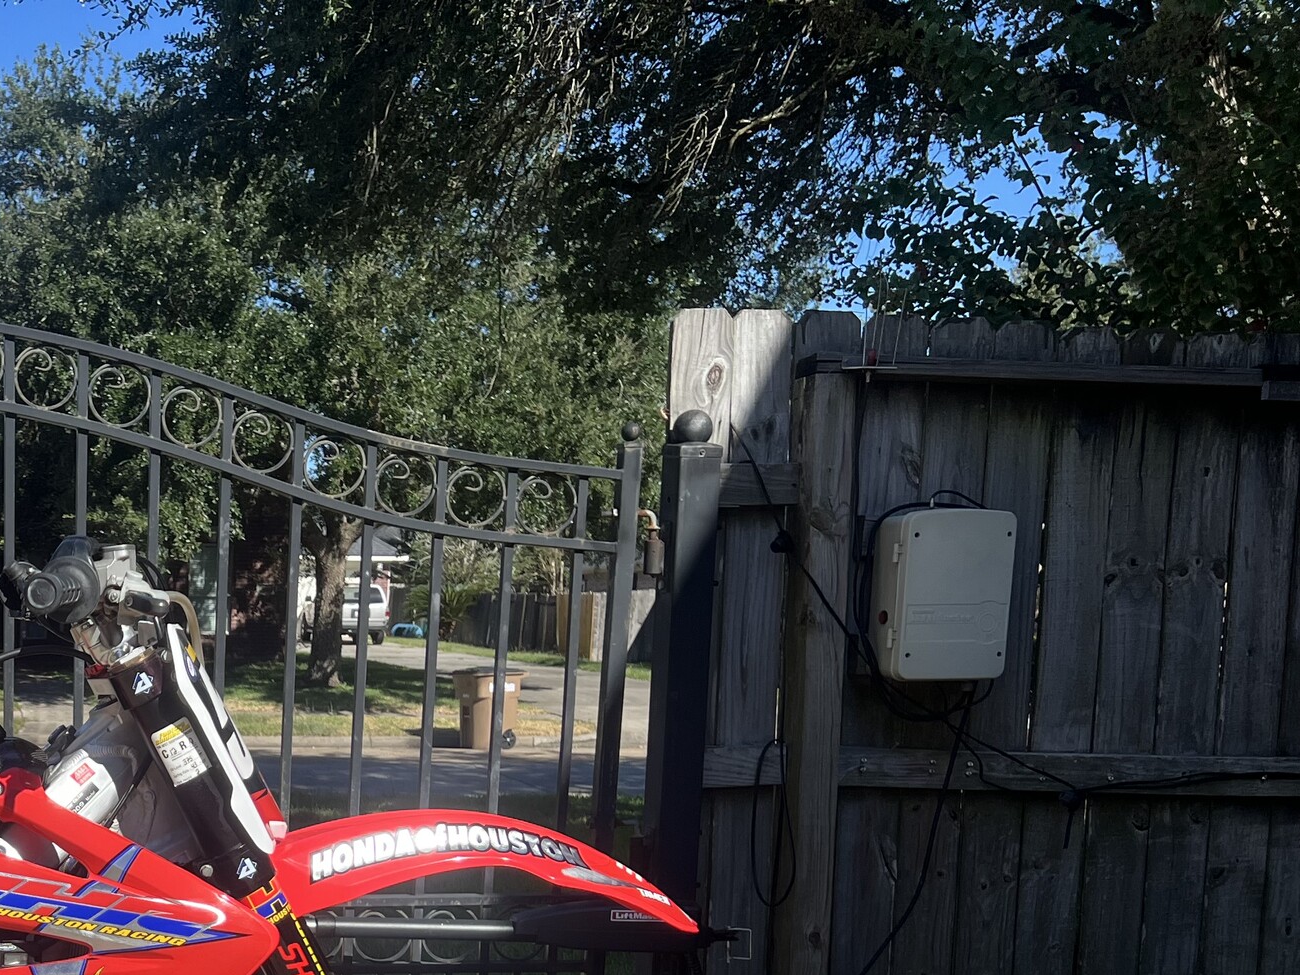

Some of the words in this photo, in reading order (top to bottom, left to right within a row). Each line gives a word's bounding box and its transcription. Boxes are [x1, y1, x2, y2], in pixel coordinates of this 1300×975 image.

[311, 828, 417, 881] HONDA
[448, 824, 588, 869] HOUSTON
[99, 925, 188, 947] RACING
